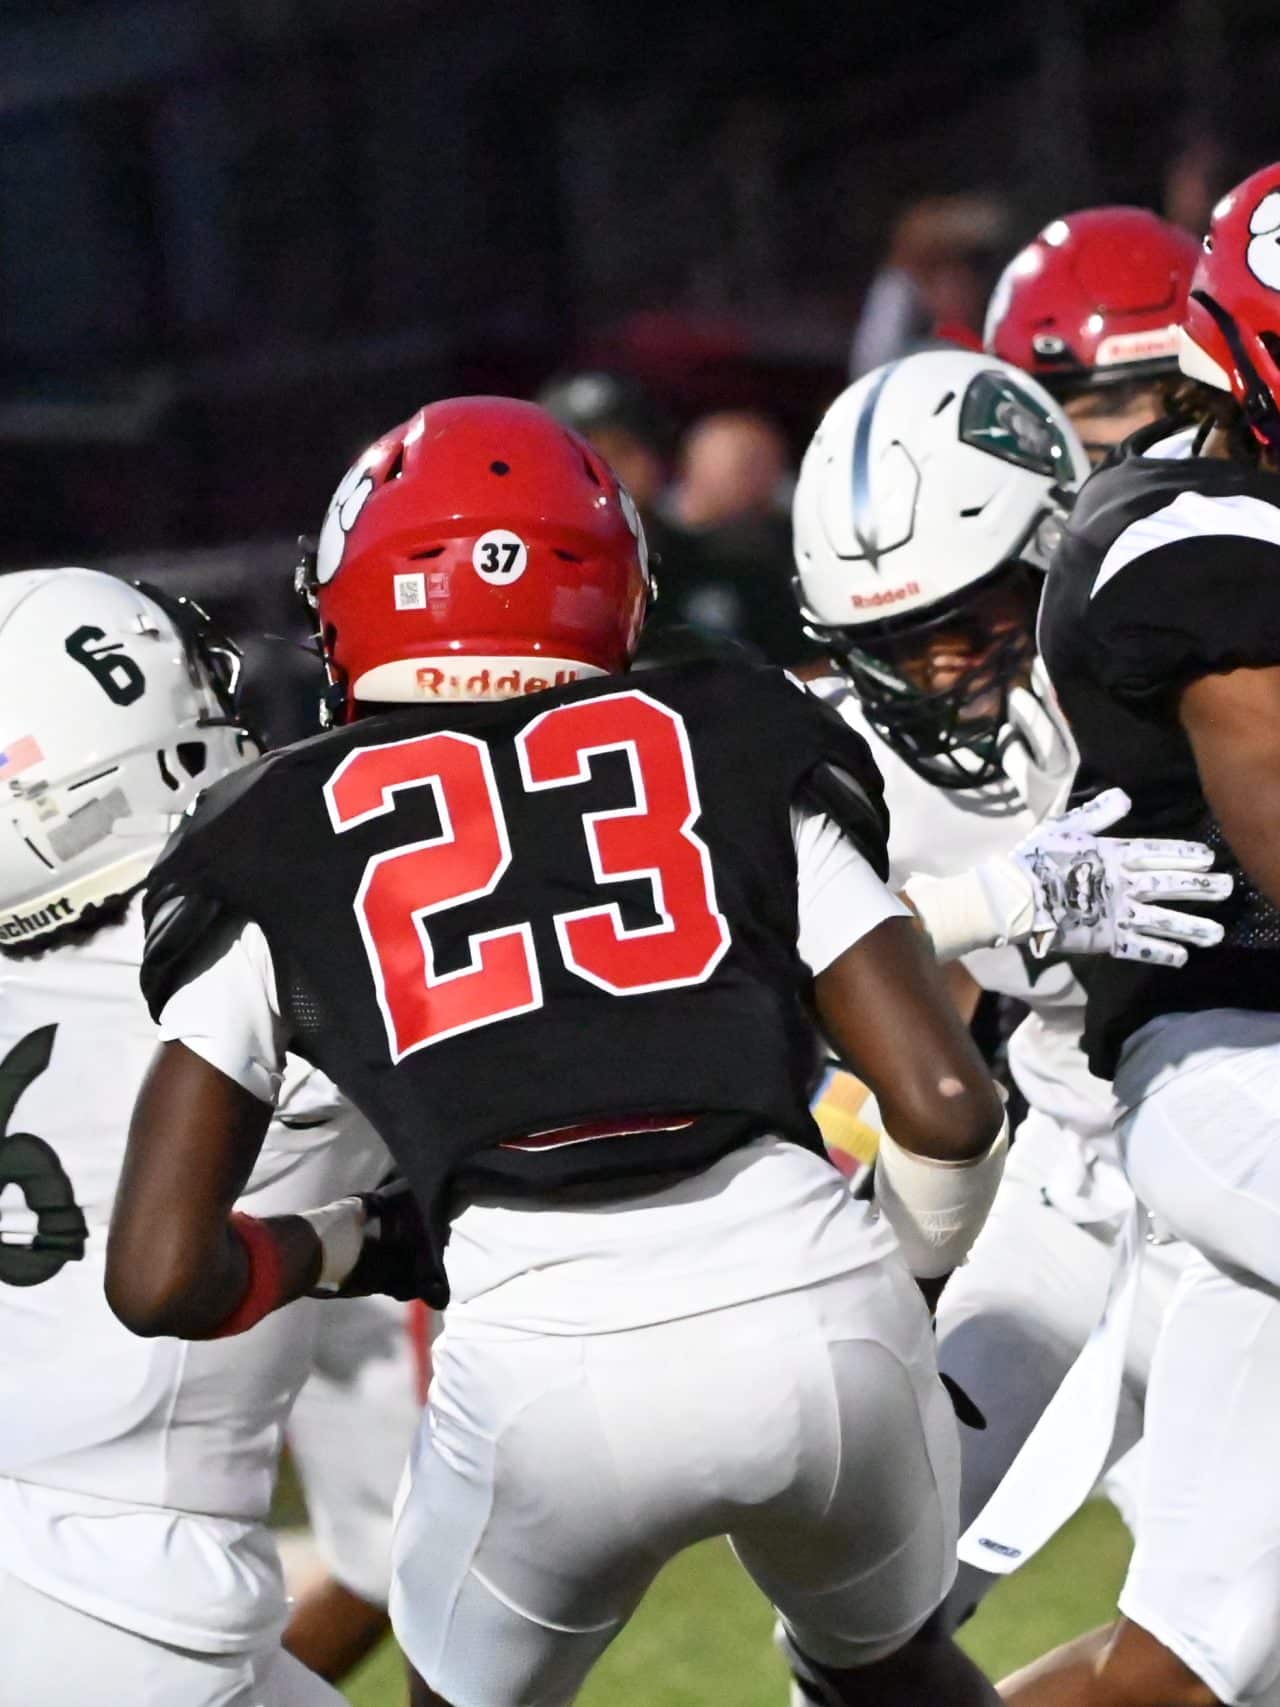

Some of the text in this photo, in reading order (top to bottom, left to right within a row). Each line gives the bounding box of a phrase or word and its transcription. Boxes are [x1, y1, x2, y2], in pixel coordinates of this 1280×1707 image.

[480, 543, 521, 573] 37
[65, 625, 145, 706] 6
[322, 689, 732, 1065] 23
[0, 1022, 89, 1287] 6
